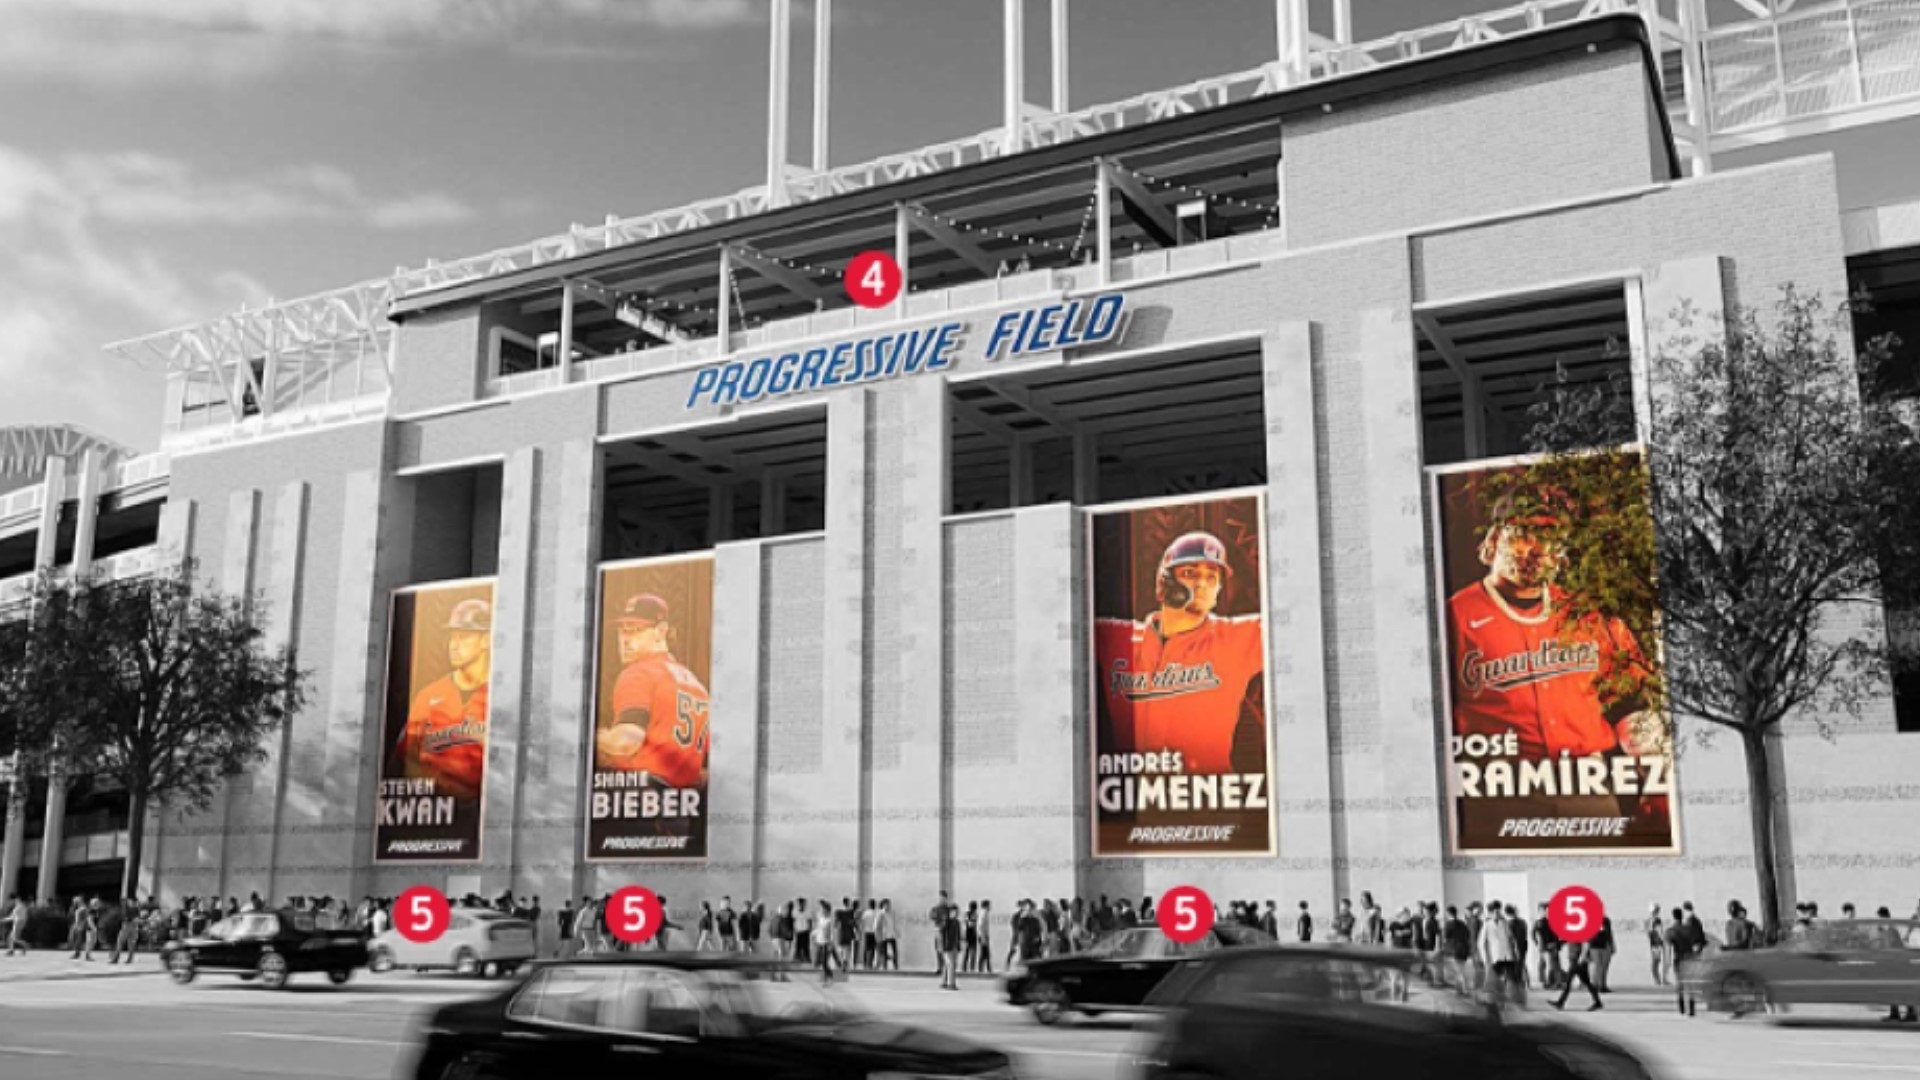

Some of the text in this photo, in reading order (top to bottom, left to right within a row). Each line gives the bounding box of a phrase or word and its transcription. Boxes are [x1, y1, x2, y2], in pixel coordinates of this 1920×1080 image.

[687, 294, 1124, 408] PROGRESSIVE FIELD
[1110, 658, 1222, 701] Guadians
[1451, 731, 1519, 757] JOSÉ
[1098, 748, 1183, 775] ANDRÉS
[1455, 748, 1670, 797] RAMÍREZ
[380, 777, 436, 796] STEVEN
[594, 770, 649, 788] SHANE
[1099, 773, 1268, 811] GIMENEZ
[378, 796, 455, 826] KWAN
[592, 788, 701, 819] BIEBER
[1128, 824, 1236, 843] PROGRESSIVE
[1498, 816, 1630, 838] PROGRESSIVE
